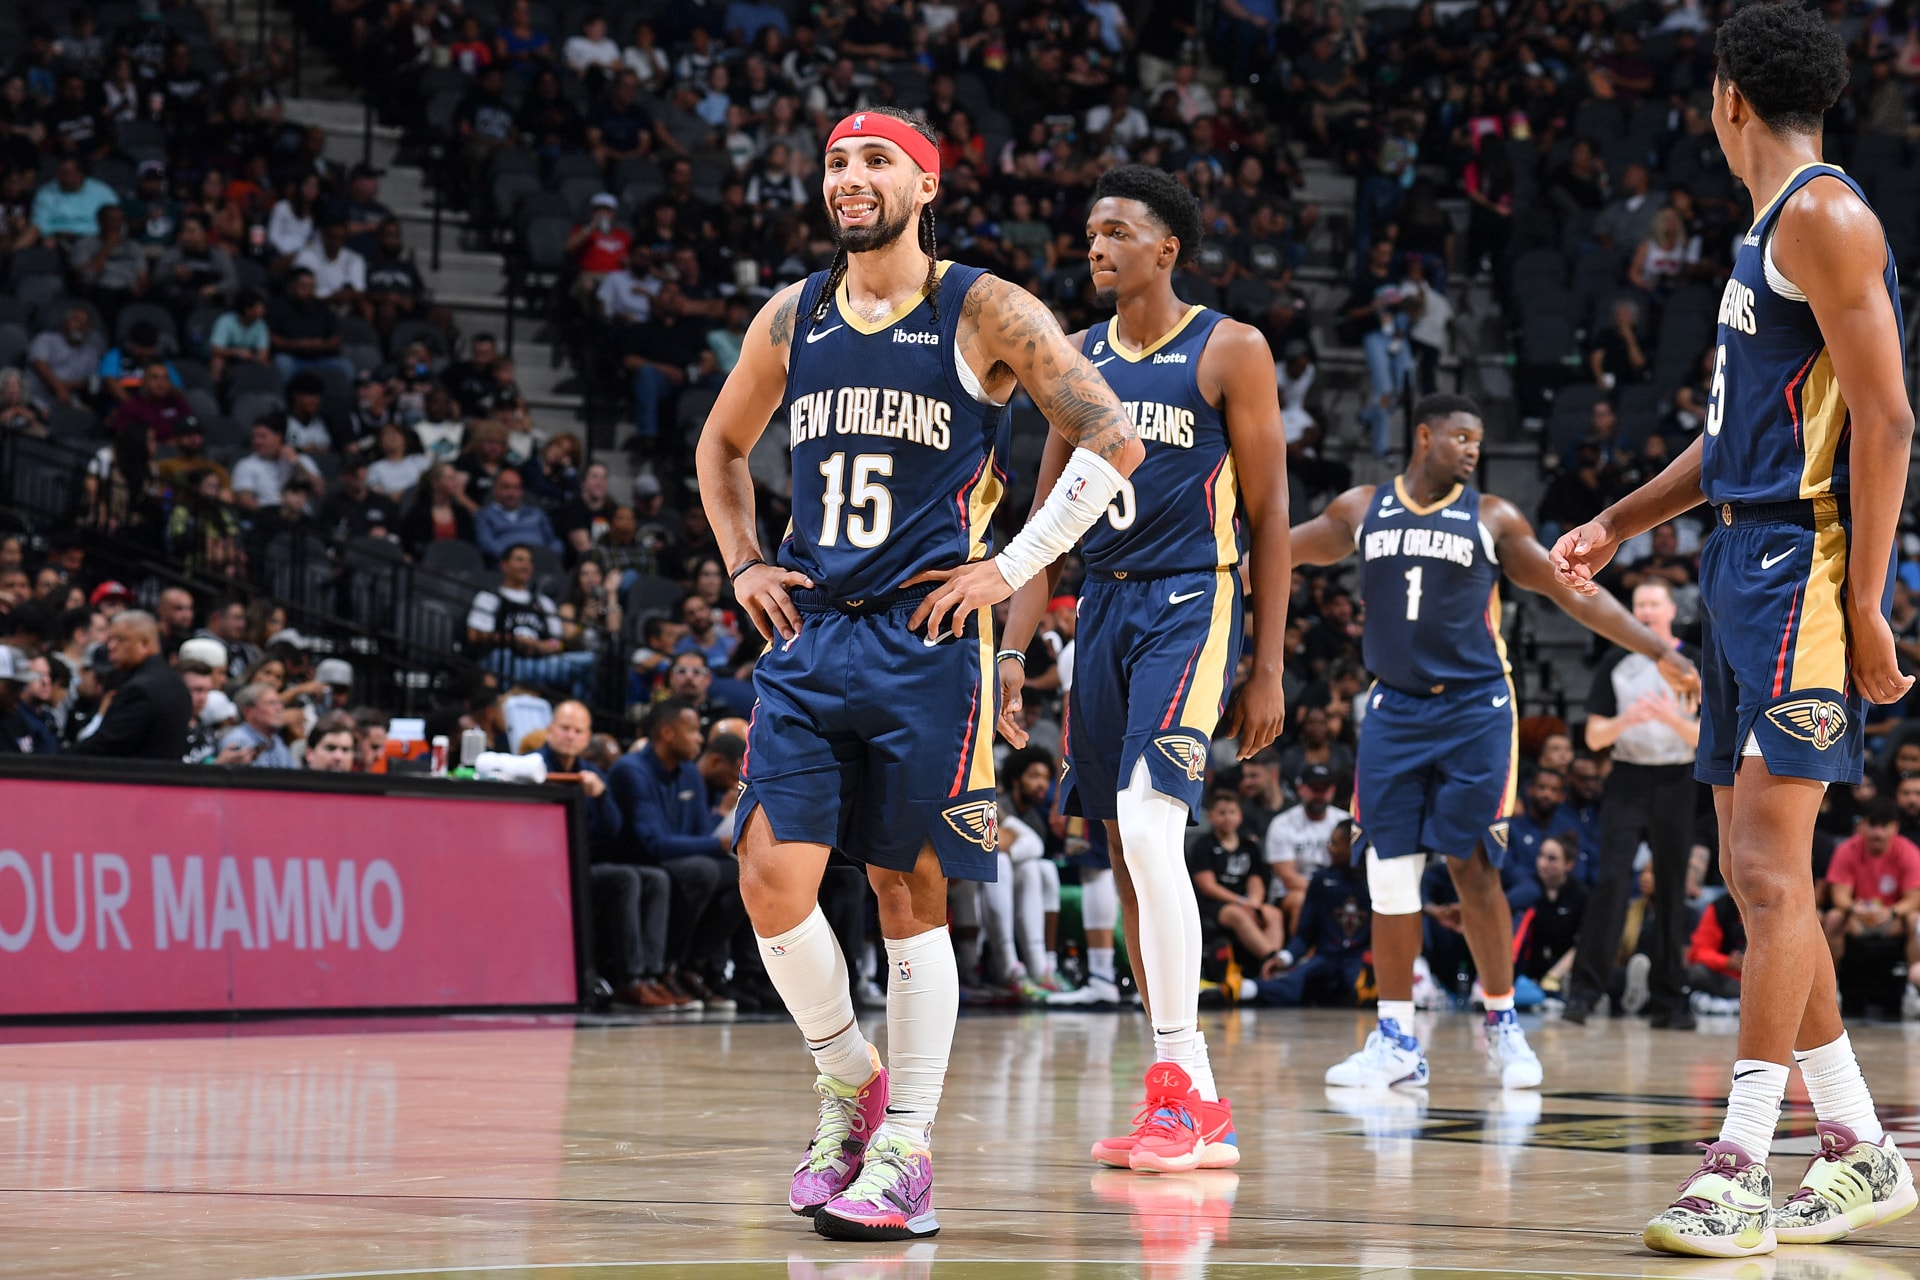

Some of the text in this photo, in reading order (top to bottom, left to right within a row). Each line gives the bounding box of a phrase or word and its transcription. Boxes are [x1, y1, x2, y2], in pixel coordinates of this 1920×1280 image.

[892, 328, 940, 345] ibotta
[1092, 340, 1106, 356] 6
[1152, 352, 1188, 365] ibotta
[789, 386, 952, 452] NEW ORLEANS
[1121, 400, 1195, 449] LEANS
[818, 451, 894, 549] 15
[1365, 528, 1475, 567] NEW ORLEANS
[1404, 565, 1423, 621] 1
[0, 849, 404, 953] OUR MAMMO
